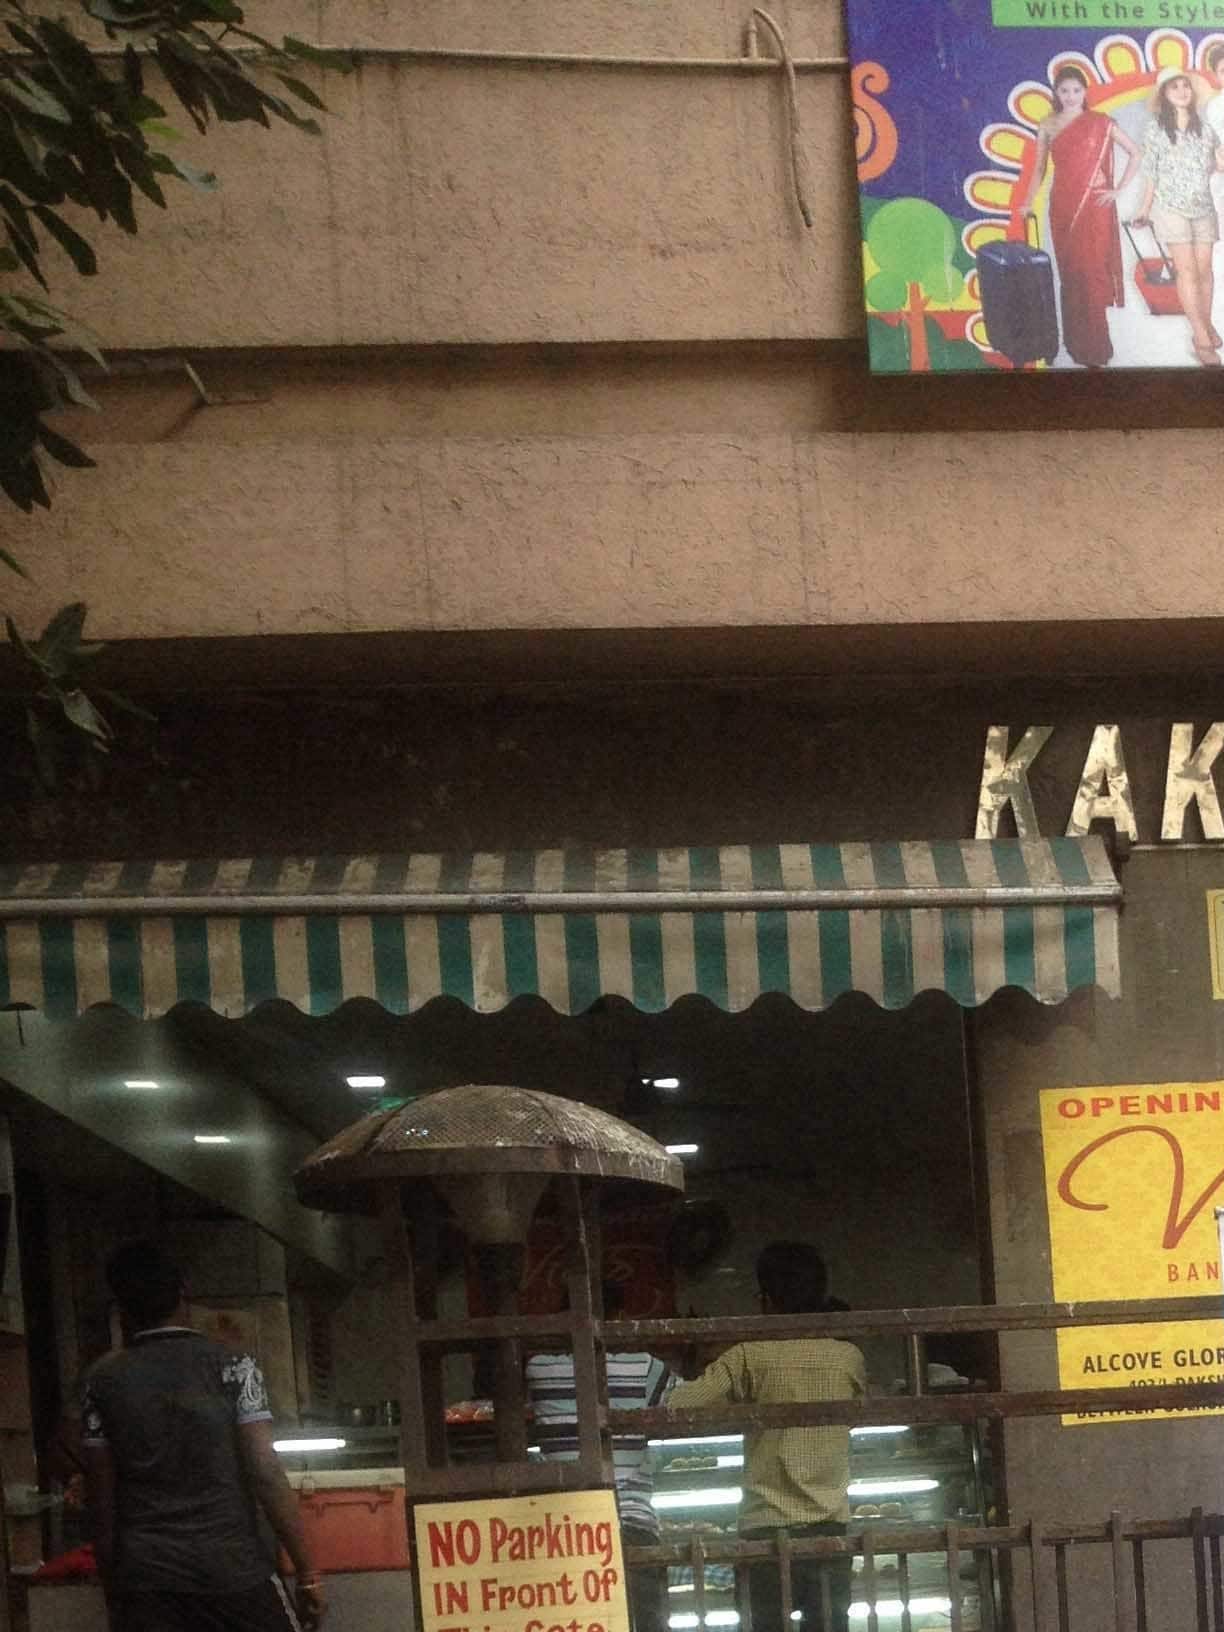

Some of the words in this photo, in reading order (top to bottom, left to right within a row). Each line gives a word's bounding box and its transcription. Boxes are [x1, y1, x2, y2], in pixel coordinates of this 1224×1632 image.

[1025, 0, 1088, 18] With
[1103, 0, 1144, 18] the
[1159, 0, 1224, 22] Style
[1082, 1351, 1163, 1374] ALCOVE
[427, 1518, 482, 1569] NO
[488, 1511, 614, 1568] Parking
[433, 1580, 469, 1617] IN
[480, 1572, 578, 1613] Front
[582, 1567, 619, 1603] Of
